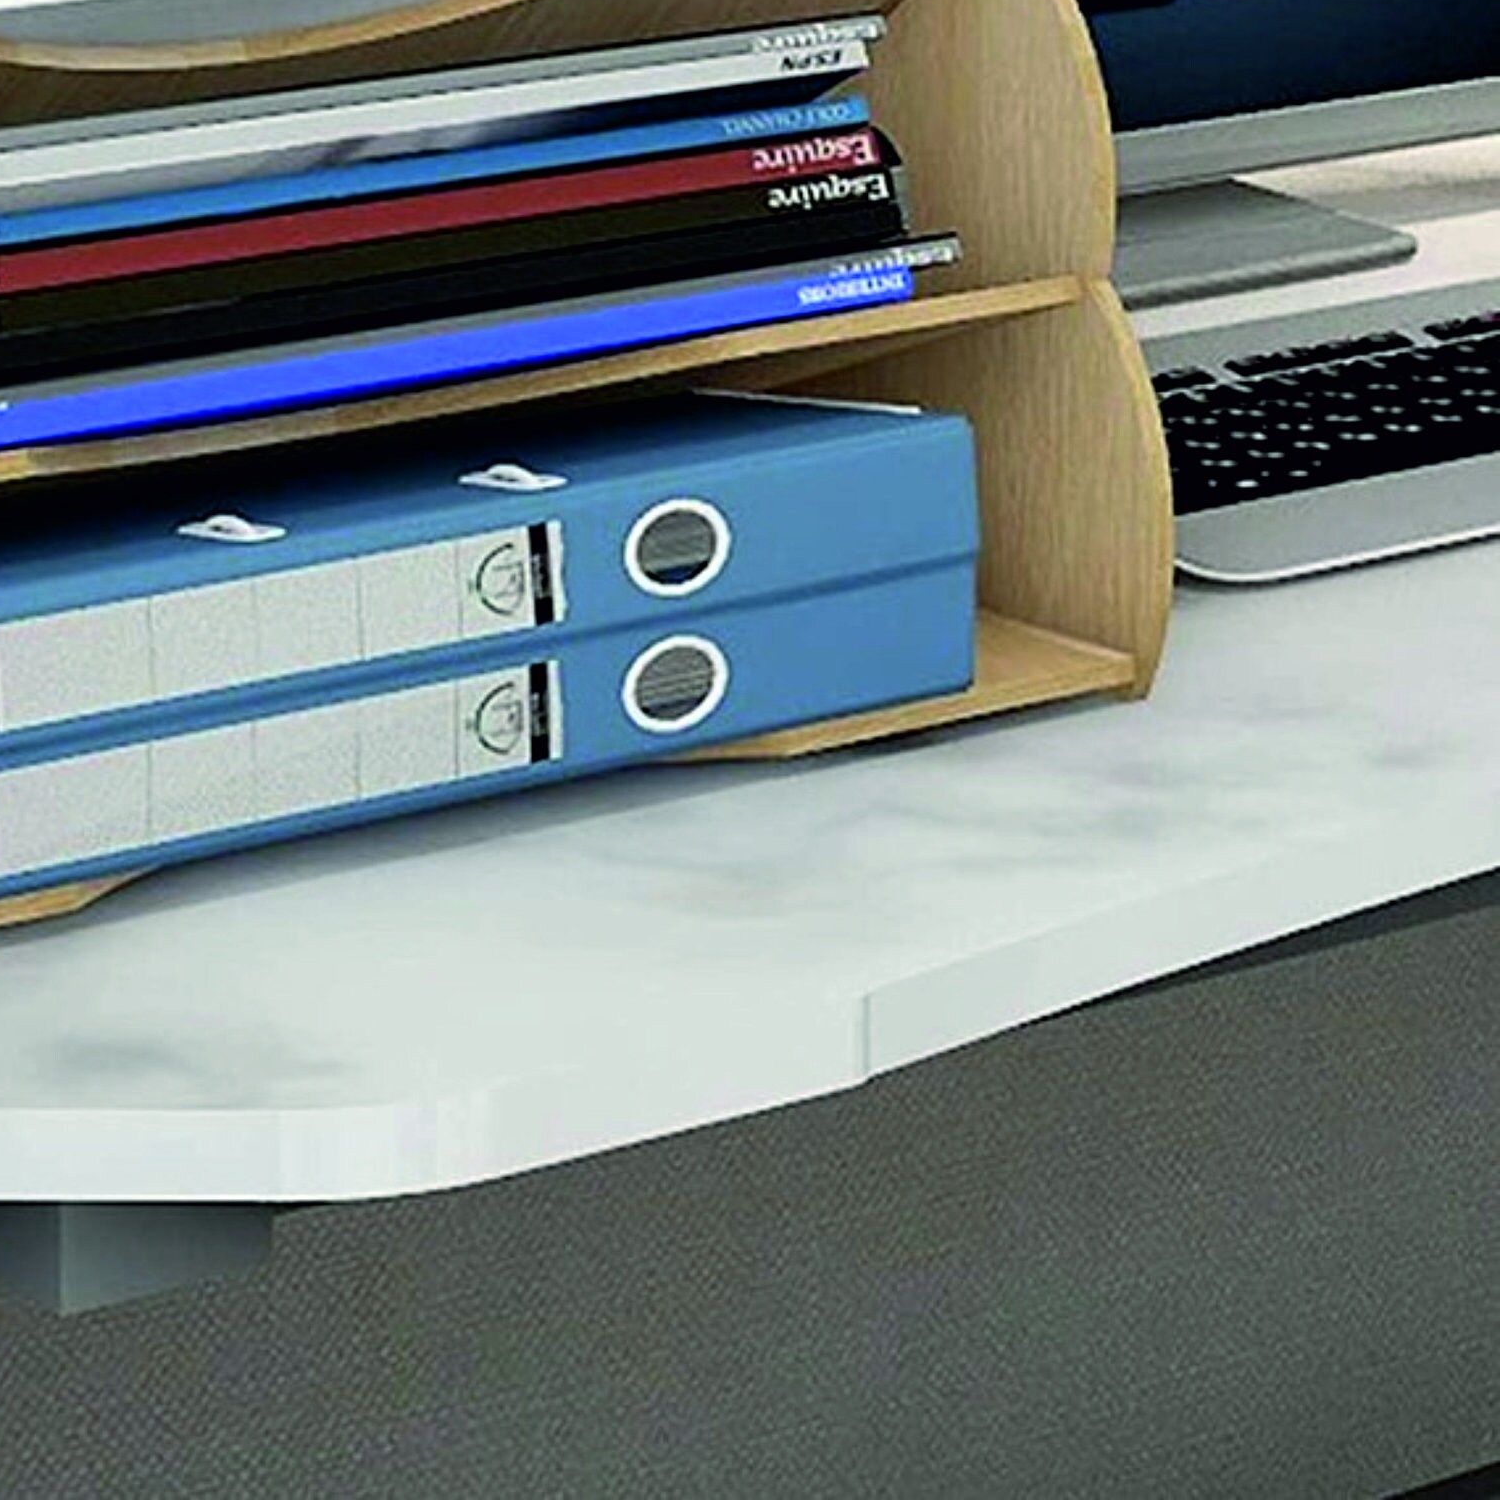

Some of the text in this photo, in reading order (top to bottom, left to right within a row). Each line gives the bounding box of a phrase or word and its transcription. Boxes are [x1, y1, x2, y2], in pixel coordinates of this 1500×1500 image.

[780, 49, 842, 73] ESPN
[753, 132, 881, 172] Esquire
[768, 173, 890, 209] Esquire
